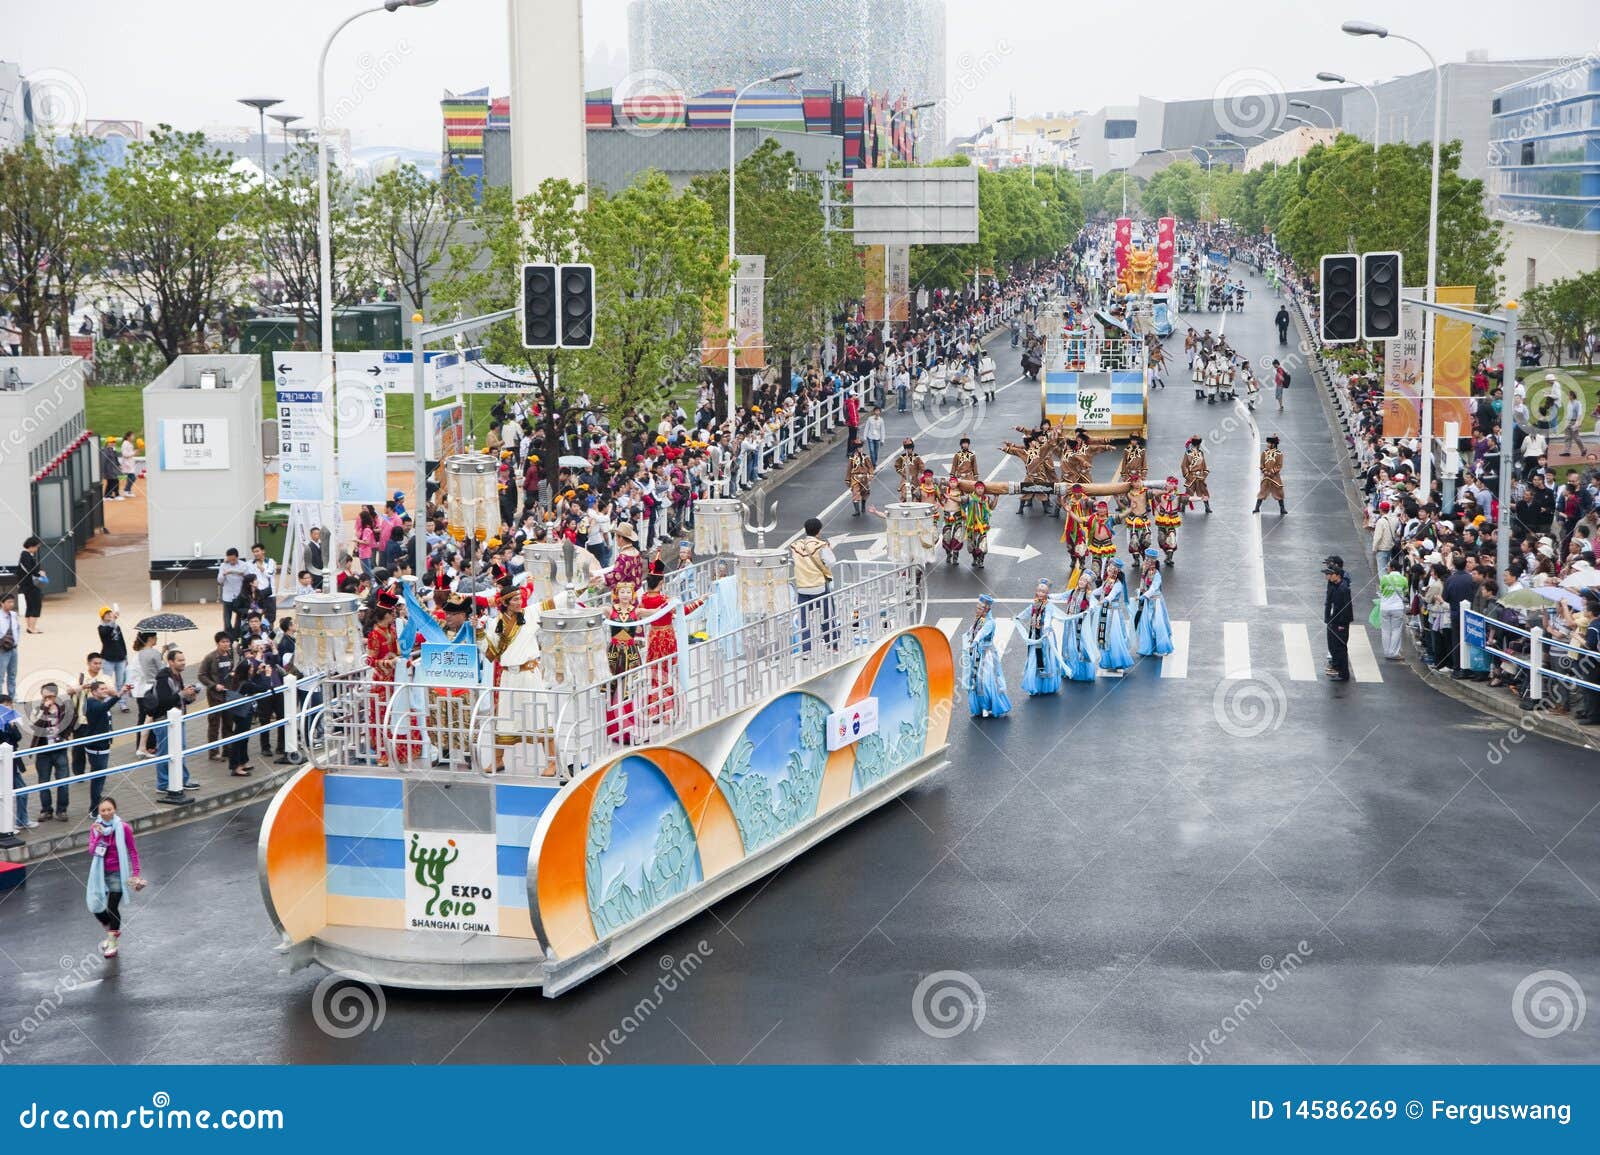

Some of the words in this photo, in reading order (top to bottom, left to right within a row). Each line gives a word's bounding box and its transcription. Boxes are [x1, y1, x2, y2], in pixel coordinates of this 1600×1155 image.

[1403, 328, 1417, 385] 欧洲广场
[430, 651, 469, 665] 内蒙古
[451, 885, 492, 900] EXPO
[411, 918, 460, 930] SHANGHAI
[462, 922, 491, 932] CHINA
